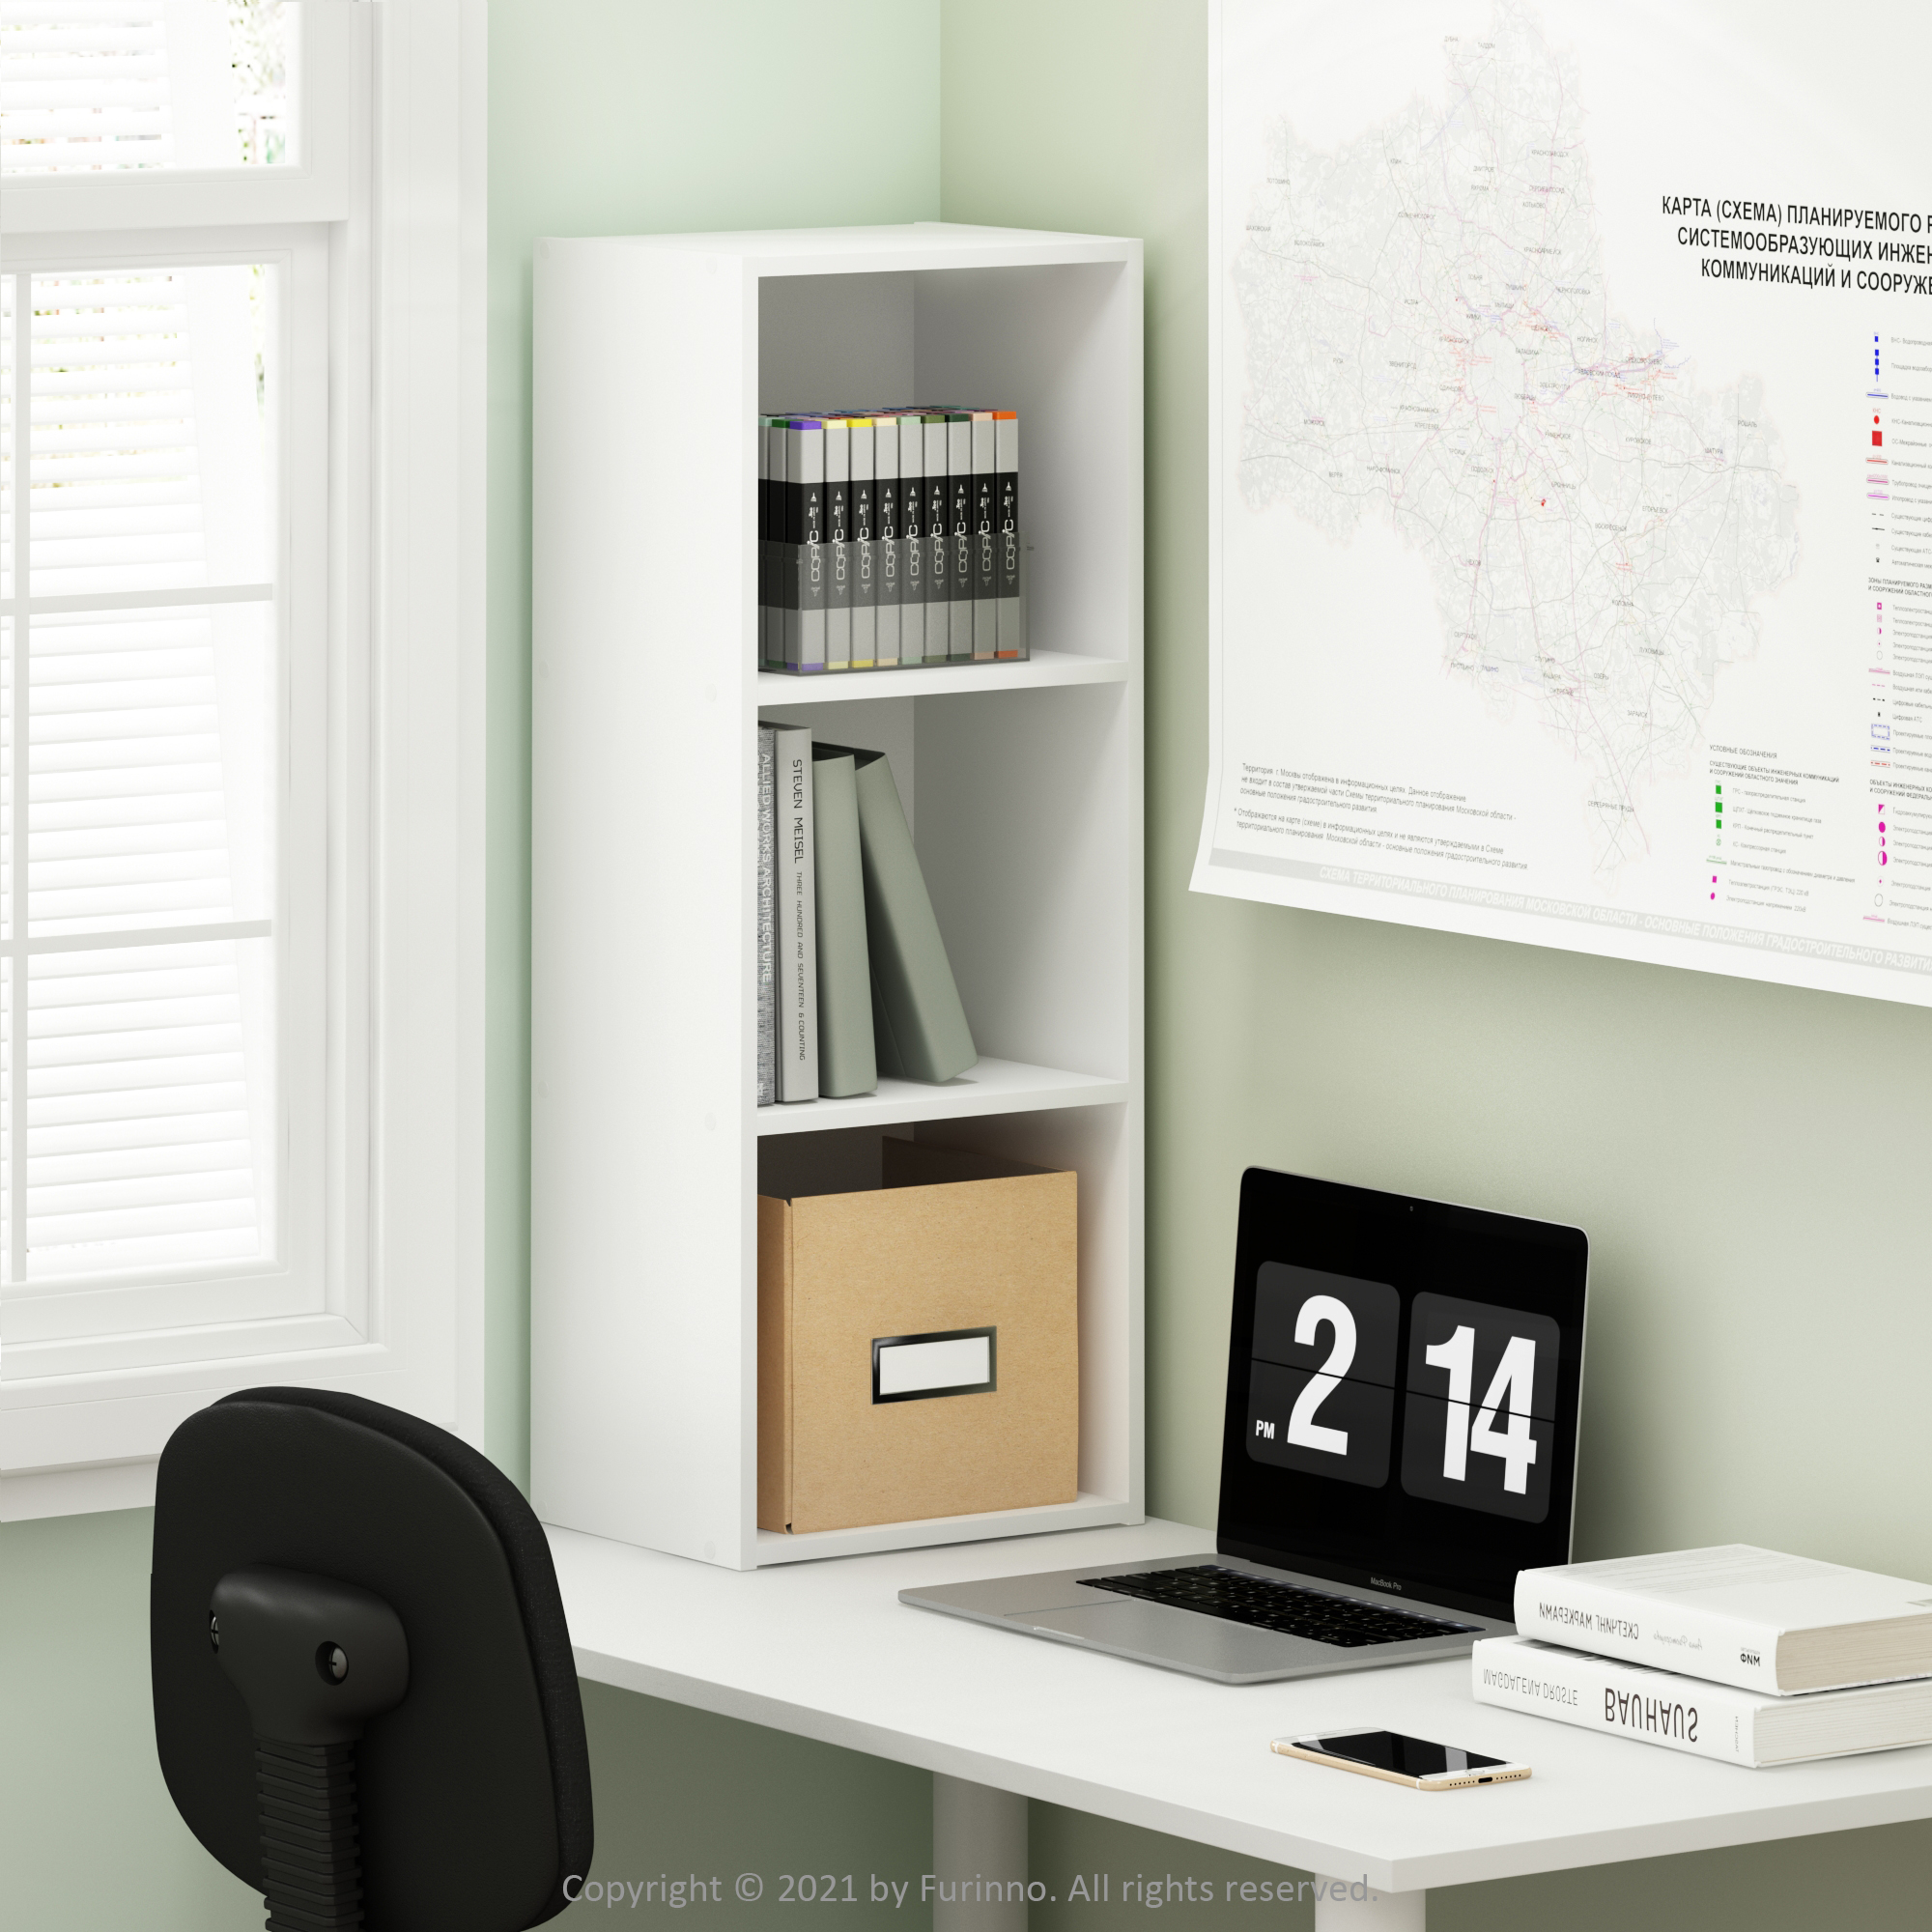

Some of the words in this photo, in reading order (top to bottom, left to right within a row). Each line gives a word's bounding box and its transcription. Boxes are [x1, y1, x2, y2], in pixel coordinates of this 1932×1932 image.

[1662, 195, 1712, 217] КАРТА
[1717, 199, 1782, 228] (СХЕМА)
[1787, 205, 1921, 234] ПЛАНИРУЕМОГО
[1678, 227, 1873, 262] СИСТЕМООБРАЗУЮЩИХ
[1701, 258, 1835, 289] КОММУНИКАЦИЙ
[1841, 270, 1851, 289] И
[1710, 745, 1738, 753] УСЛОВНЫЕ
[1739, 748, 1777, 759] ОБОЗНАЧЕНИЯ
[761, 753, 772, 806] ALLIED
[792, 759, 803, 809] STEVEN
[1240, 788, 1265, 797] основные
[1267, 790, 1296, 801] положения
[1297, 796, 1350, 810] градостроительного
[1242, 763, 1273, 775] Территория
[1281, 769, 1301, 779] Москвы
[1302, 773, 1334, 783] отображена
[1341, 779, 1388, 791] информационных
[1408, 786, 1429, 797] Данное
[1431, 791, 1466, 802] отображение
[1273, 781, 1291, 789] состав
[1346, 789, 1364, 799] Схемы
[1365, 794, 1414, 807] территориального
[1415, 800, 1455, 812] планирования
[1457, 806, 1489, 816] Московской
[1491, 810, 1513, 820] области
[762, 810, 772, 863] WORKS
[794, 817, 804, 865] MEISEL
[1237, 821, 1284, 834] территориального
[1286, 829, 1323, 839] планирования
[1326, 833, 1358, 844] Московской
[1359, 838, 1381, 848] области
[1386, 843, 1412, 853] основные
[1414, 847, 1444, 857] положения
[1443, 852, 1500, 866] градостроительного
[1238, 809, 1277, 820] Отображаются
[1327, 823, 1376, 835] информационных
[1407, 835, 1433, 843] являются
[1435, 839, 1479, 850] утверждаемыми
[1486, 844, 1503, 854] Схеме
[762, 867, 772, 983] ARCHITECTURE
[1320, 866, 1350, 883] СХЕМА
[1353, 870, 1447, 897] ТЕРРИТОРИАЛЬНОГО
[1450, 884, 1524, 910] ПЛАНИРОВАНИЯ
[1526, 895, 1591, 919] МОСКОВСКОЙ
[1593, 905, 1637, 924] ОБЛАСТИ
[1645, 914, 1700, 936] ОСНОВНЫЕ
[1702, 921, 1763, 945] ПОЛОЖЕНИЯ
[1766, 930, 1883, 964] ГРАДОСТРОИТЕЛЬНОГО
[1287, 1294, 1357, 1456] 2
[1425, 1324, 1537, 1495] 14
[1256, 1420, 1275, 1439] PM
[1371, 1577, 1392, 1589] MacBook
